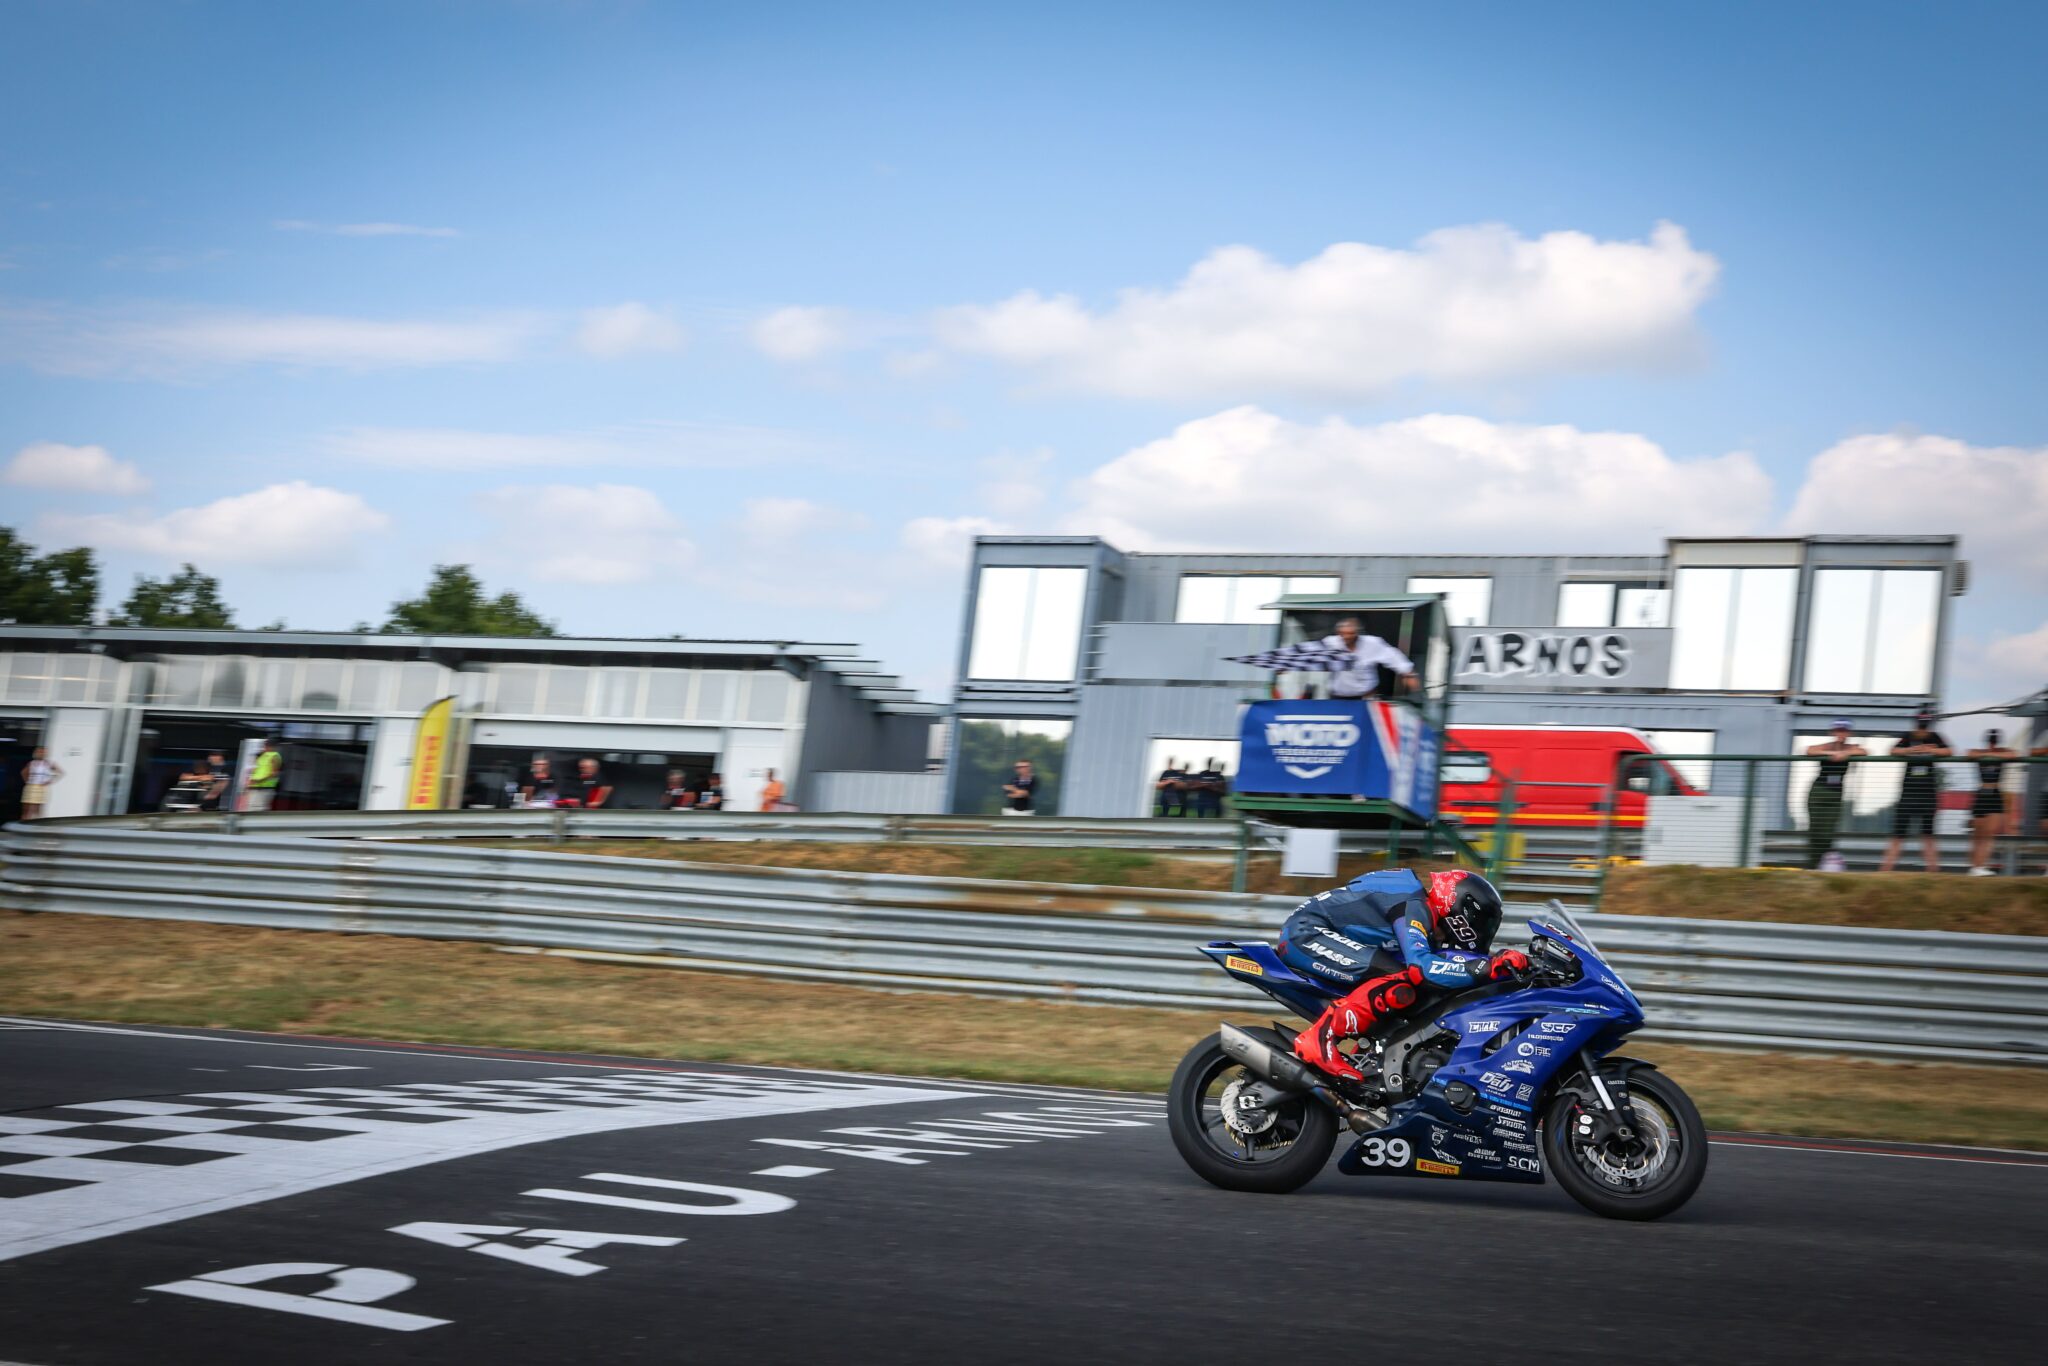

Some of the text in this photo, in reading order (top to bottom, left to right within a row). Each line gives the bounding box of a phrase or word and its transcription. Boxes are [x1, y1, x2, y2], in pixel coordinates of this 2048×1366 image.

[1455, 631, 1632, 678] ARNOS
[1361, 1137, 1411, 1168] 39
[1508, 1156, 1541, 1173] SCM
